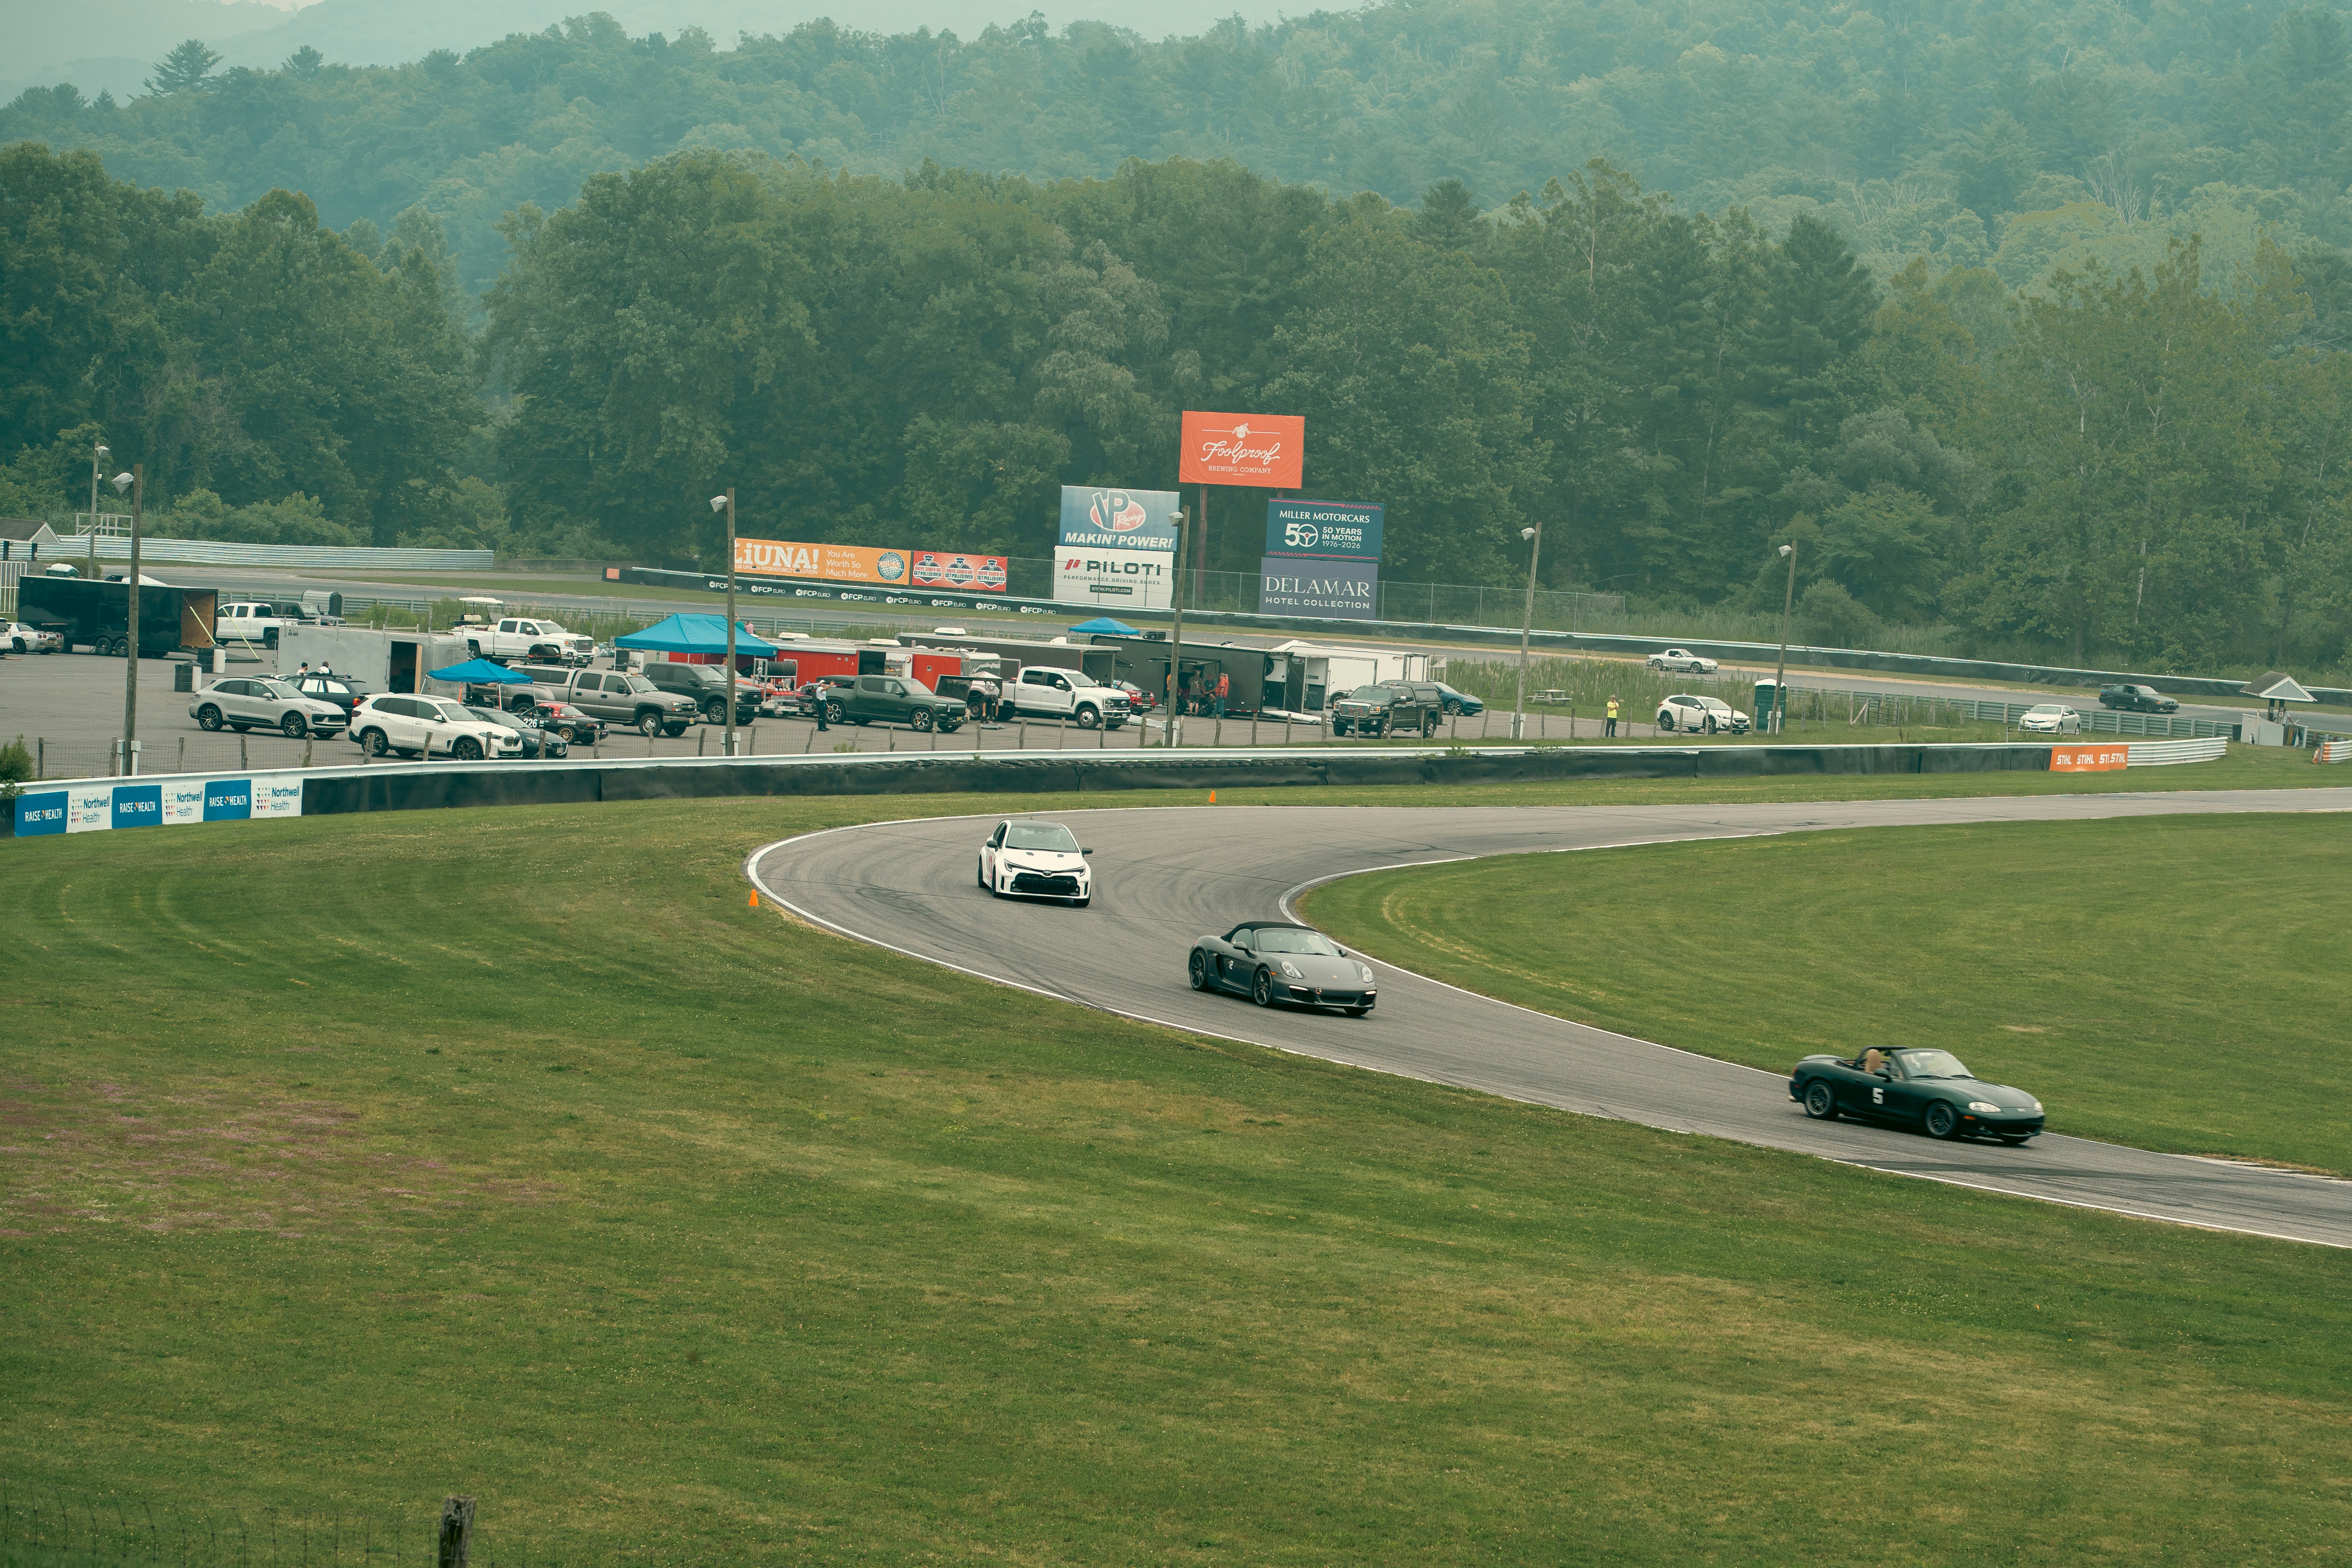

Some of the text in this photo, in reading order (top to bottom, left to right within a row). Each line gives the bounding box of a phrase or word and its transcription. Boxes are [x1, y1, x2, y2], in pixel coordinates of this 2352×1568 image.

[1200, 440, 1280, 465] Foolproof
[1092, 490, 1130, 531] VP
[1279, 510, 1370, 523] MILLER MOTORCARS
[1116, 513, 1144, 527] Racing
[1336, 527, 1362, 535] YEARS
[1065, 532, 1174, 548] MAKIN' POWER!
[827, 550, 840, 558] You
[826, 559, 849, 567] Worth
[1087, 560, 1161, 576] PILOTI
[848, 570, 869, 578] More.
[1265, 576, 1370, 597] DELAMAR
[1266, 597, 1369, 609] HOTEL COLLECTION
[523, 718, 538, 728] 226
[2057, 755, 2071, 764] STIHL
[2077, 754, 2094, 764] STIHL
[2099, 754, 2109, 764] STI
[2110, 753, 2125, 763] STIHL
[177, 791, 203, 803] Northwell
[272, 786, 299, 797] Northwell
[84, 796, 109, 809] Northwell
[120, 801, 155, 813] RAISE HEALTH
[209, 795, 246, 807] RAISE HEALTH
[271, 800, 289, 811] Health
[25, 808, 62, 822] RAISE HEALTH
[83, 812, 99, 823] Health
[177, 806, 192, 817] Health
[1873, 1088, 1883, 1104] 5
